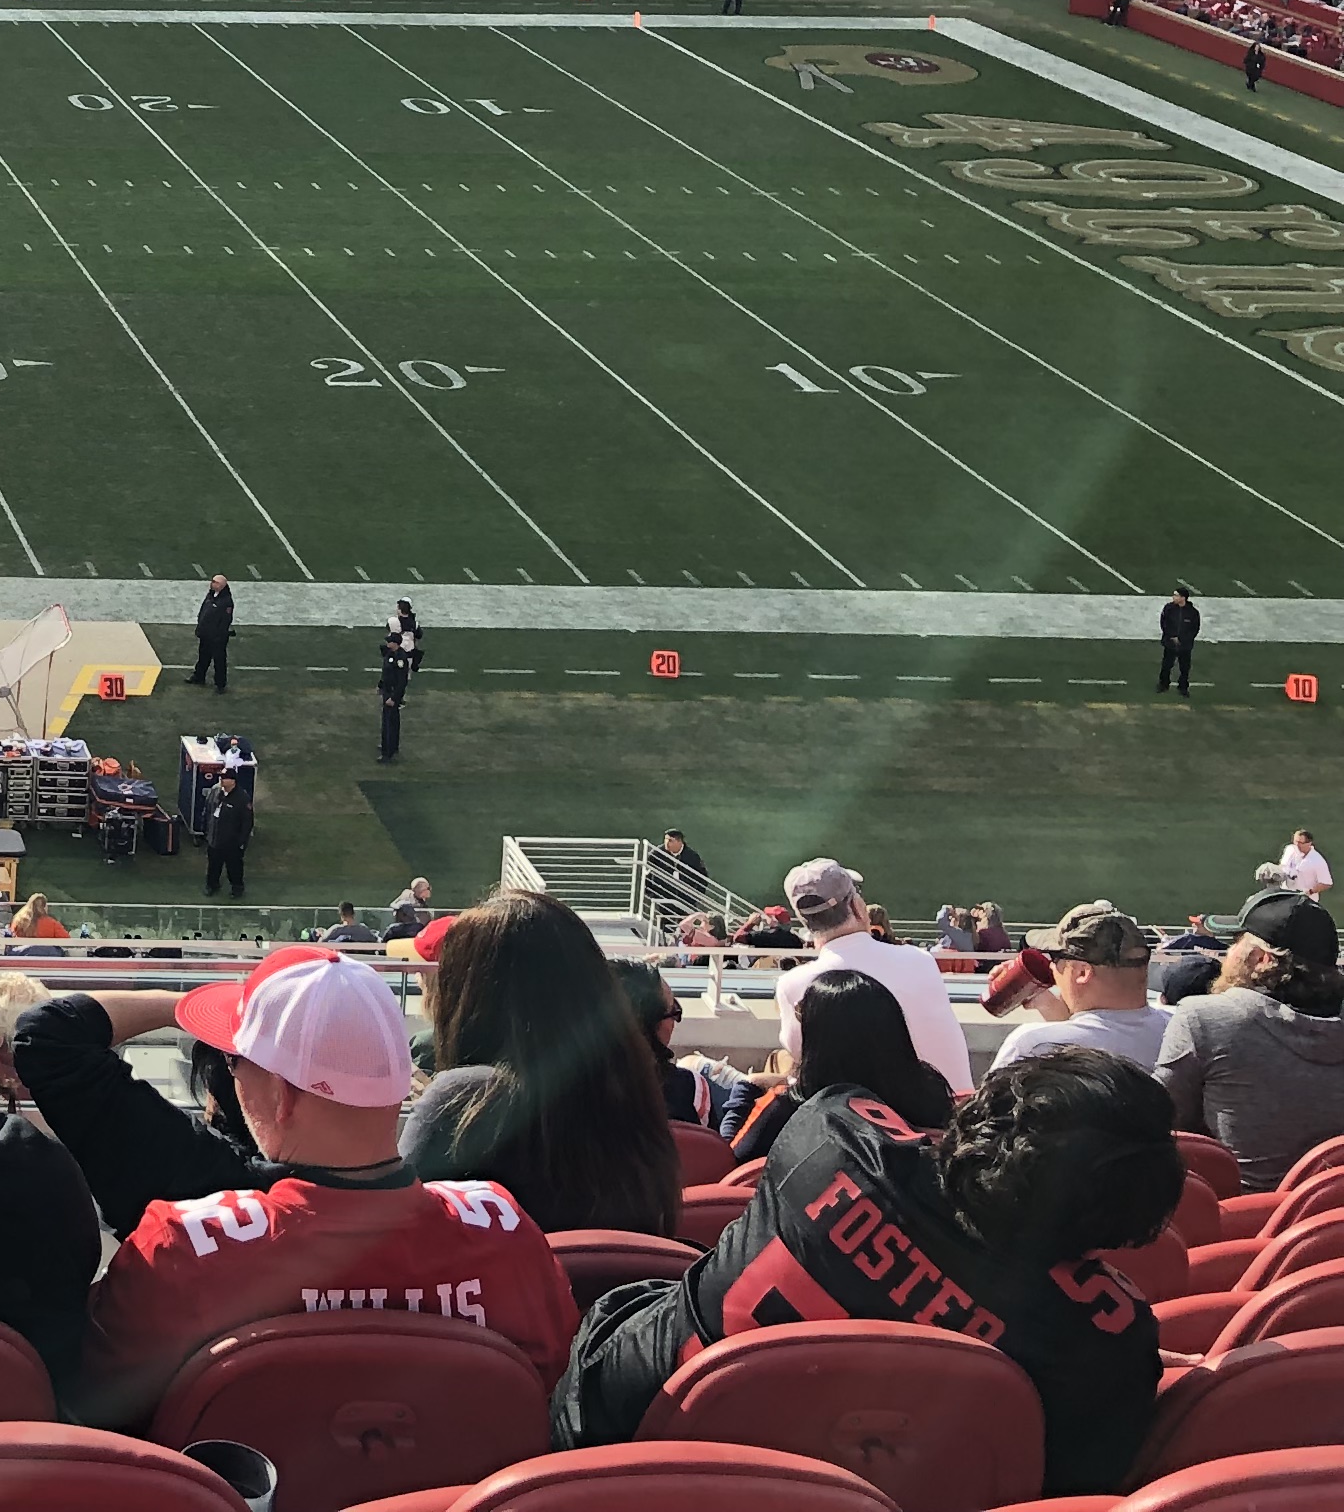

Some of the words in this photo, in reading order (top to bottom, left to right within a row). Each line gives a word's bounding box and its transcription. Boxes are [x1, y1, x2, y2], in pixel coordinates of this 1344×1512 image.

[309, 356, 468, 392] 20
[766, 362, 927, 398] 10
[655, 654, 676, 674] 20
[103, 677, 124, 698] 30
[1293, 678, 1313, 698] 10
[804, 1169, 1008, 1345] FOSTER
